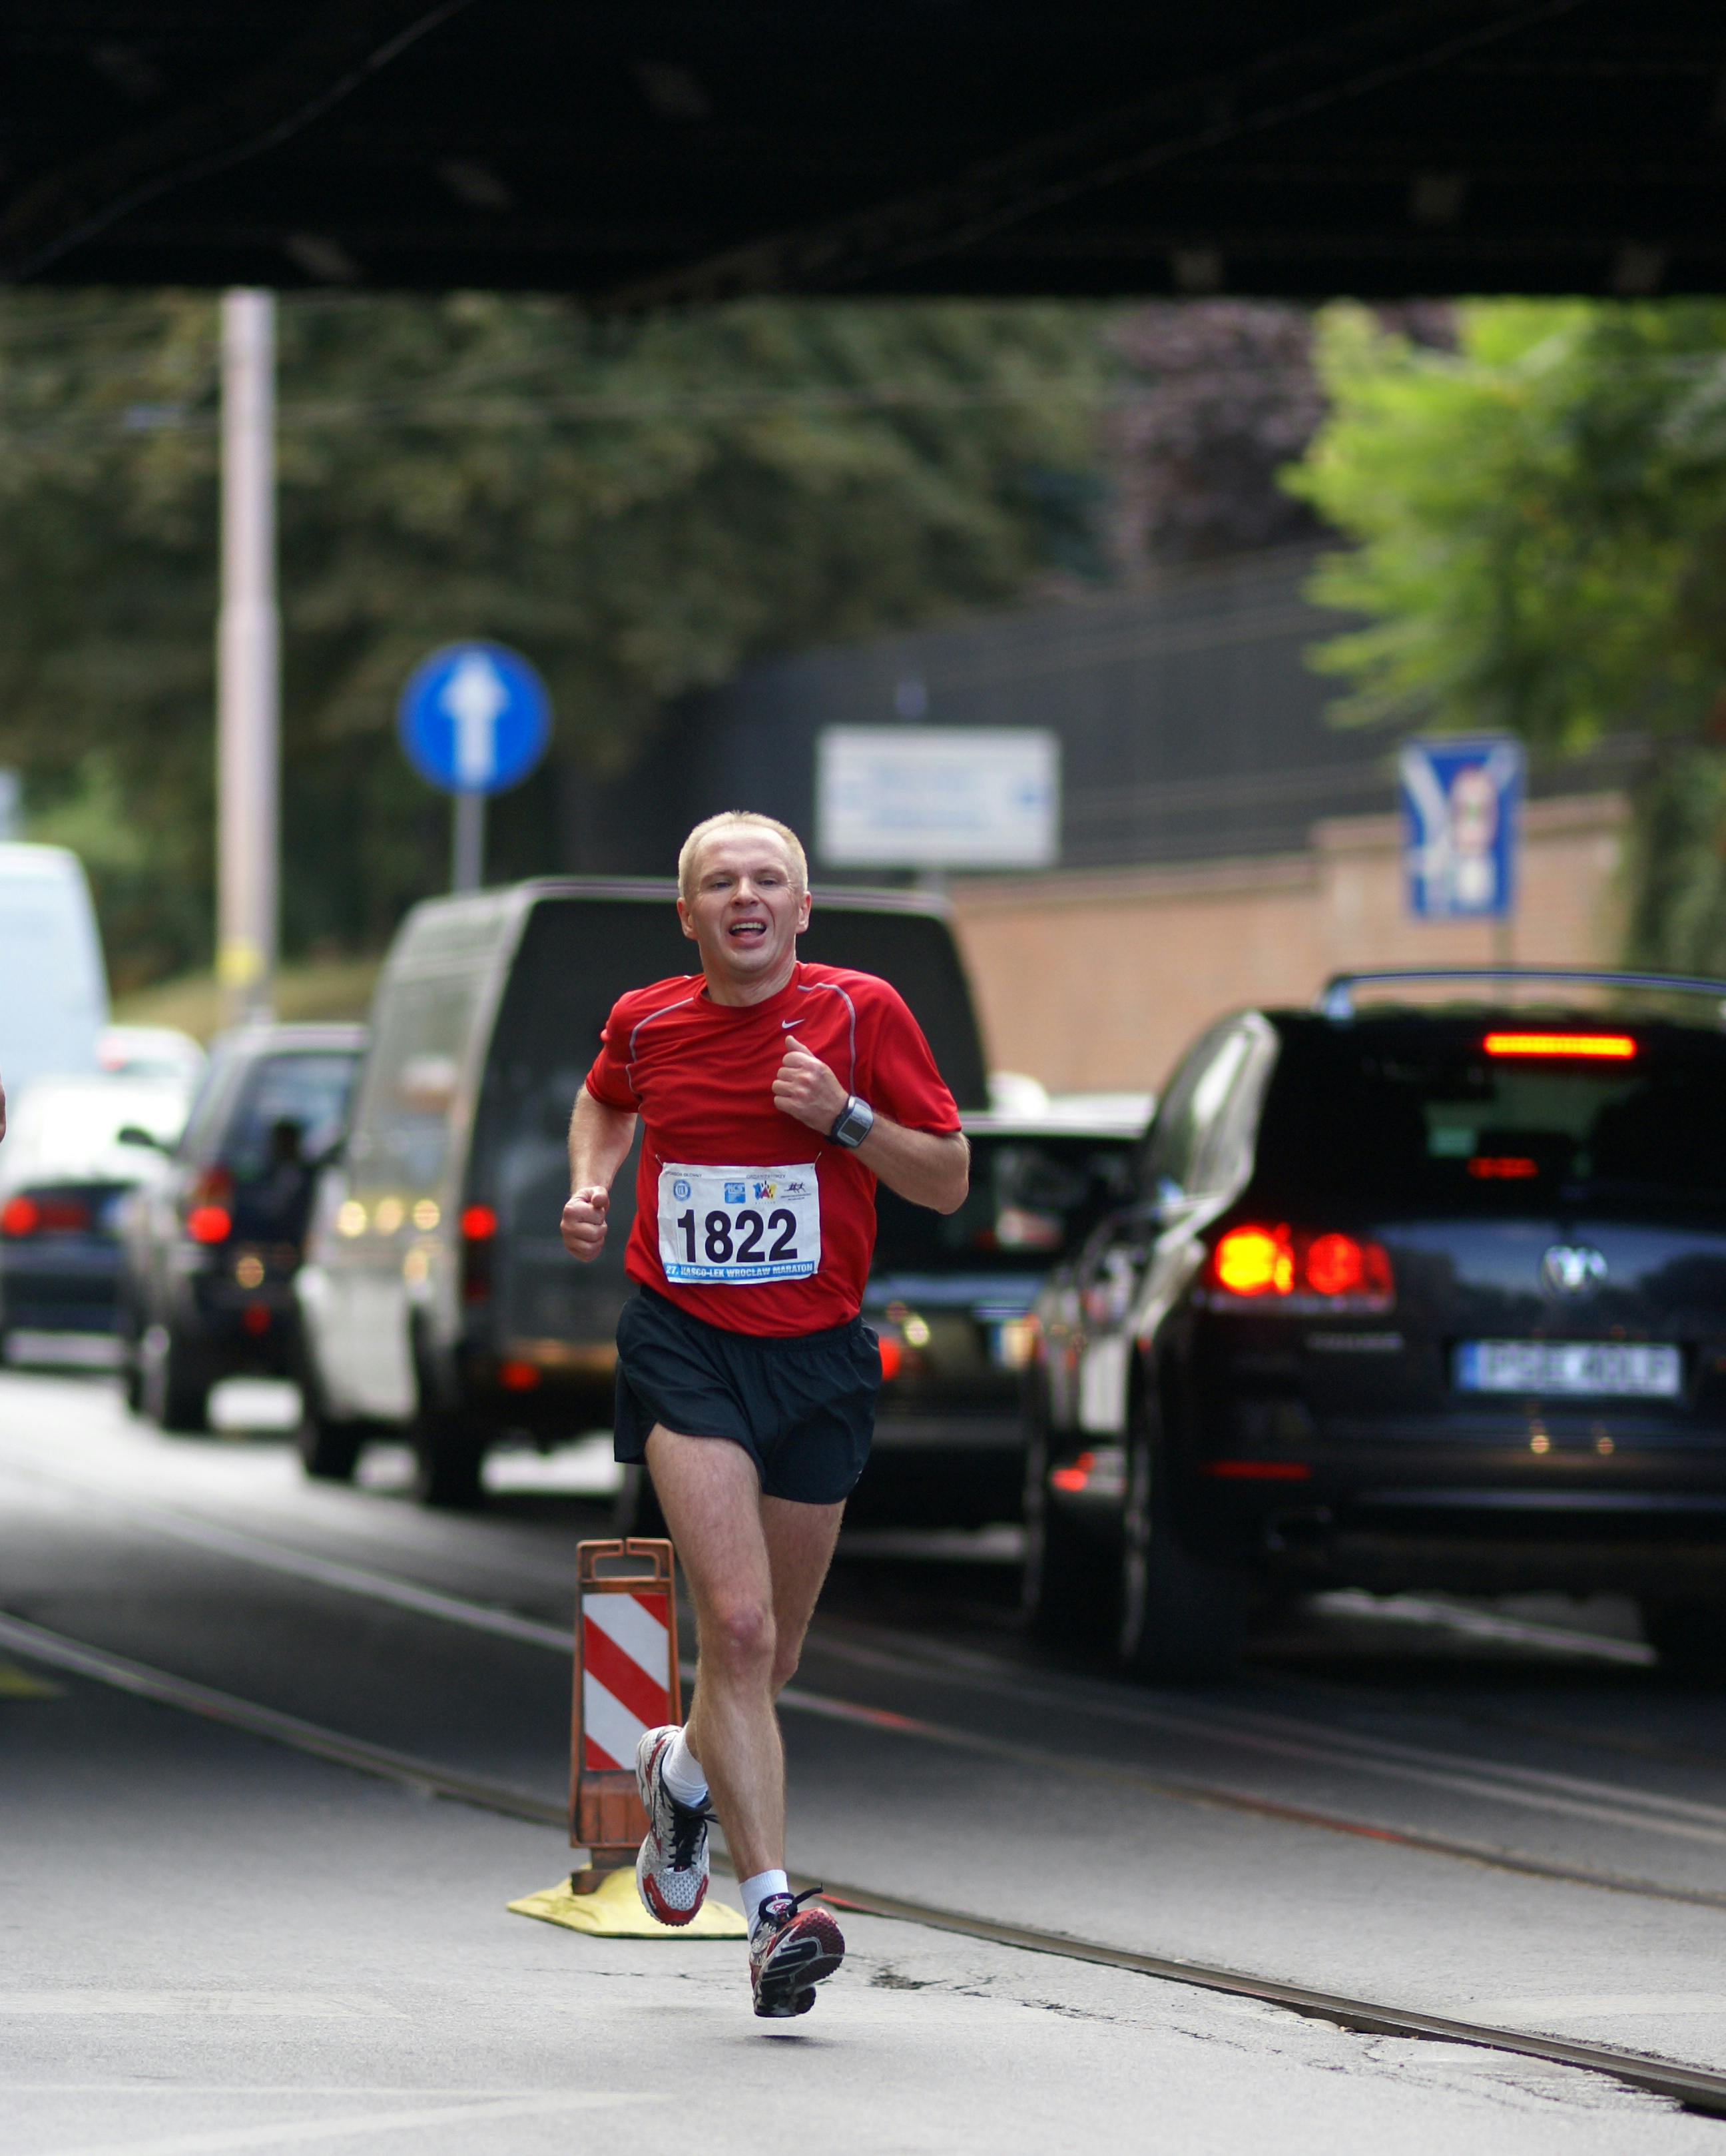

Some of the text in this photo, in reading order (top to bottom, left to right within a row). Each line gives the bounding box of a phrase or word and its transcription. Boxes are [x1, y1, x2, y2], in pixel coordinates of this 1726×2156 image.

[677, 1208, 798, 1263] 1822
[666, 1265, 679, 1275] 27.
[772, 1263, 813, 1274] MARATON
